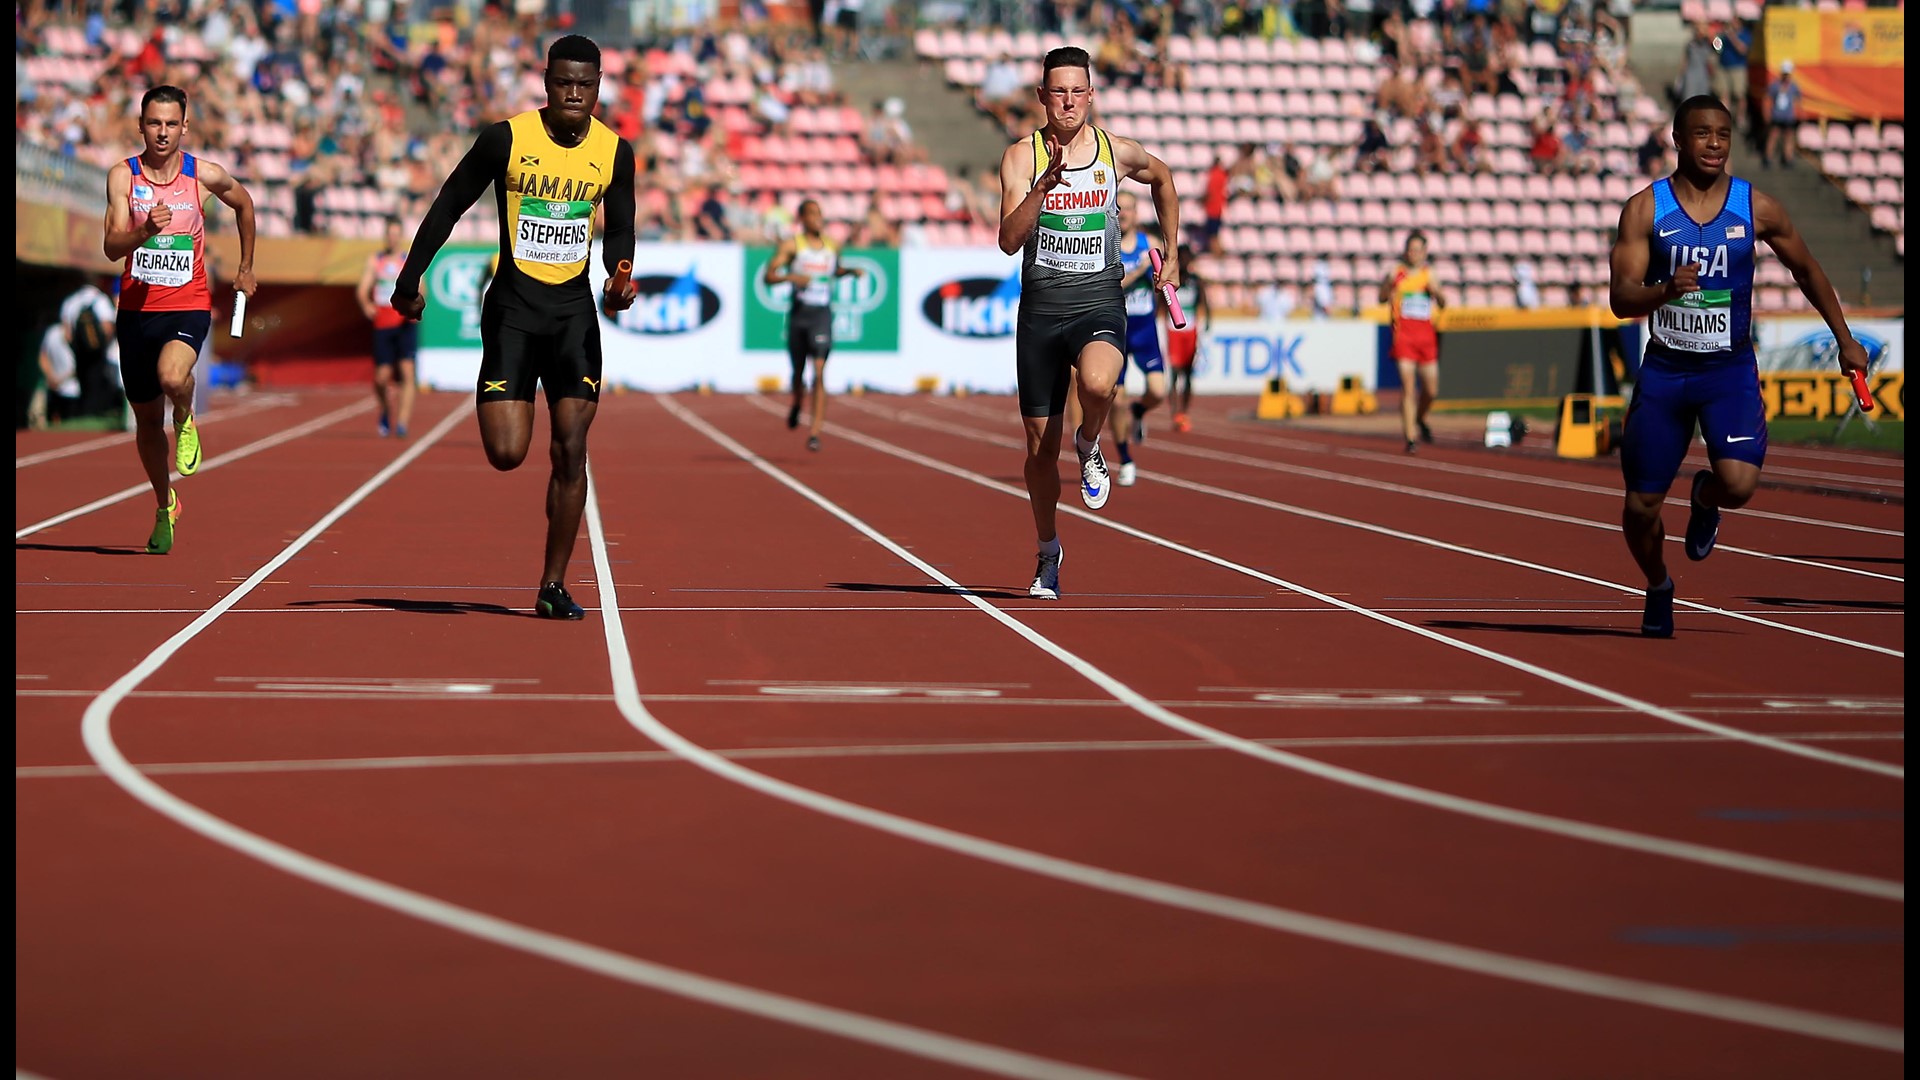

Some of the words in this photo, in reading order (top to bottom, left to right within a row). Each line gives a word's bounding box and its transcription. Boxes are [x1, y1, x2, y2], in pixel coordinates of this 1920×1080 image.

[168, 201, 194, 212] public
[1045, 189, 1108, 210] GERMANY
[520, 220, 586, 245] STEPHENS
[1041, 232, 1102, 255] BRANDNER
[136, 251, 190, 271] VEJRAŽKA
[524, 250, 561, 261] TAMPERE
[562, 252, 578, 261] 2018
[1046, 257, 1077, 270] TAMPERE
[1079, 262, 1096, 270] 2018
[1669, 245, 1728, 278] USA
[139, 273, 168, 284] TAMPERE
[169, 274, 183, 284] 2018
[1657, 311, 1727, 334] WILLIAMS
[1663, 336, 1699, 350] TAMPERE
[1701, 341, 1720, 350] 2018
[1213, 335, 1303, 376] TDK
[1761, 377, 1904, 418] EIK
